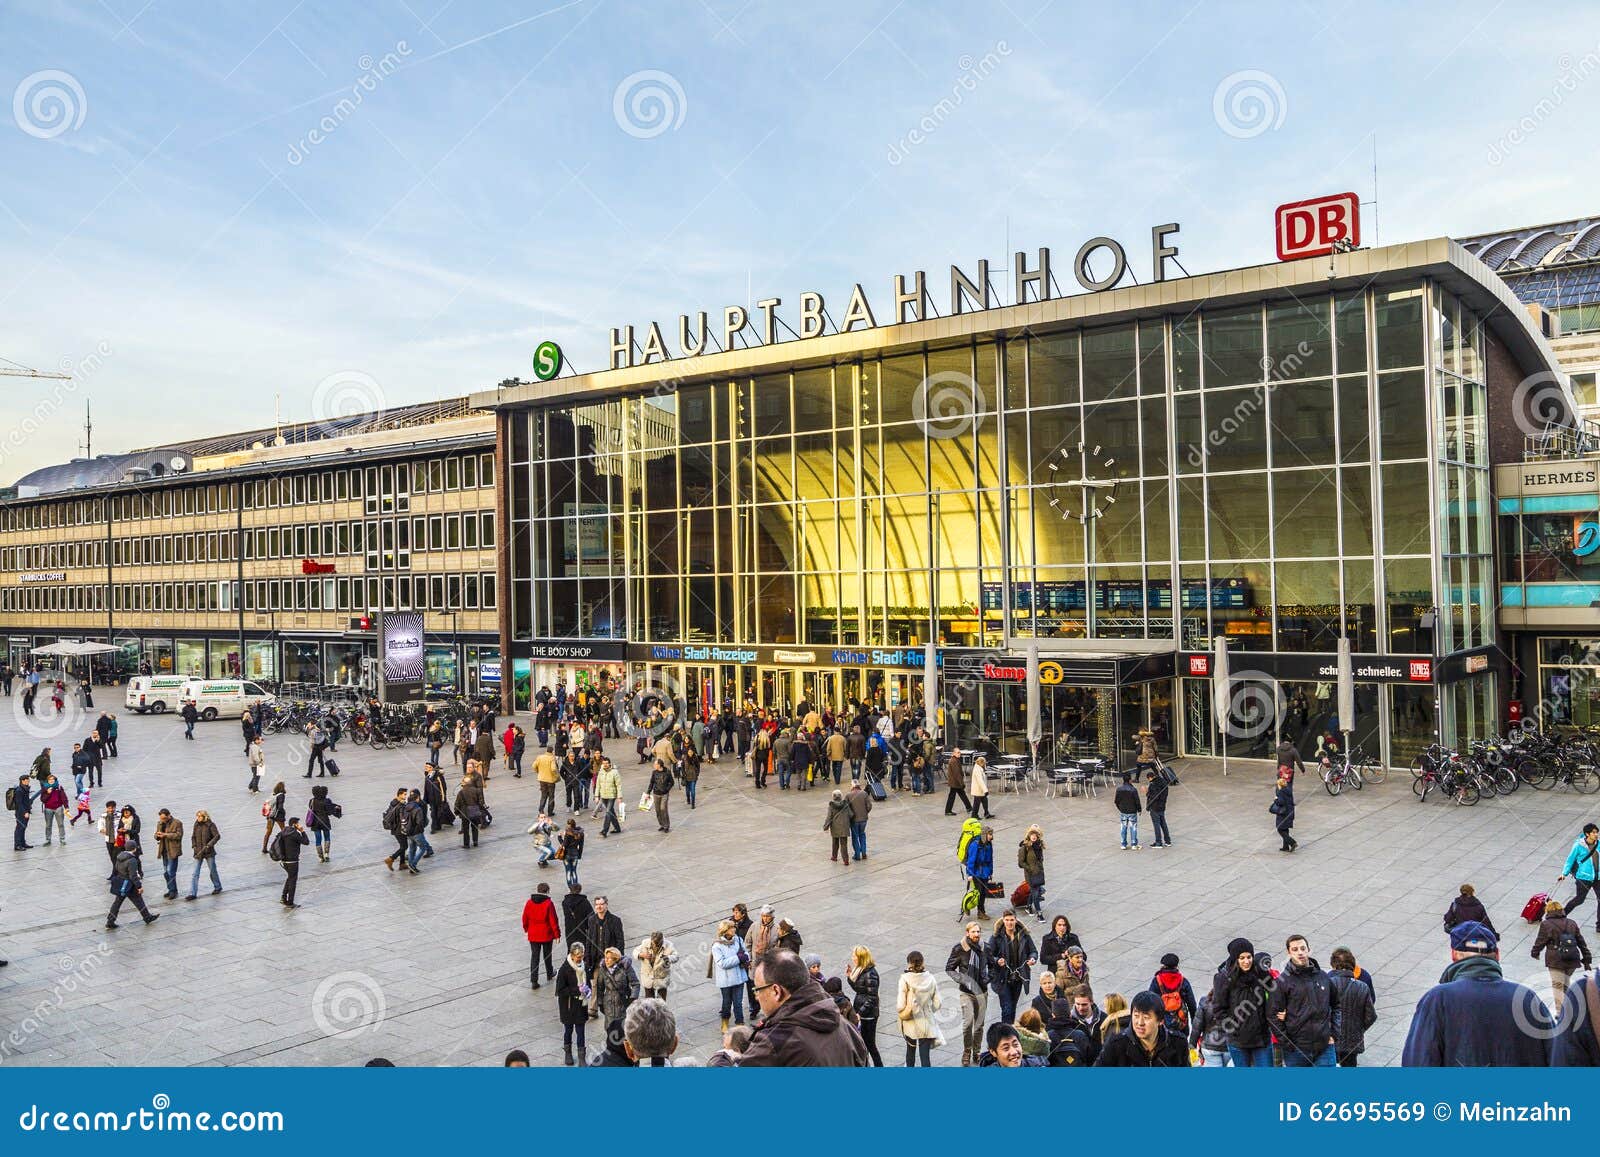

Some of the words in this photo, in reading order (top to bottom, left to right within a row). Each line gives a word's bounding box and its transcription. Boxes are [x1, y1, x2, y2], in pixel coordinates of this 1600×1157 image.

[1286, 204, 1347, 250] DB
[609, 222, 1182, 371] HAUPTBAHNHOF
[538, 346, 554, 376] S
[532, 646, 547, 656] THE
[548, 647, 569, 657] BODY
[570, 647, 592, 657] SHOP
[652, 645, 682, 659] Kölner
[684, 646, 758, 664] Stadt-Anzeiger
[831, 649, 869, 665] Kölner
[984, 663, 1027, 683] Kamp
[1357, 665, 1403, 678] schneller.
